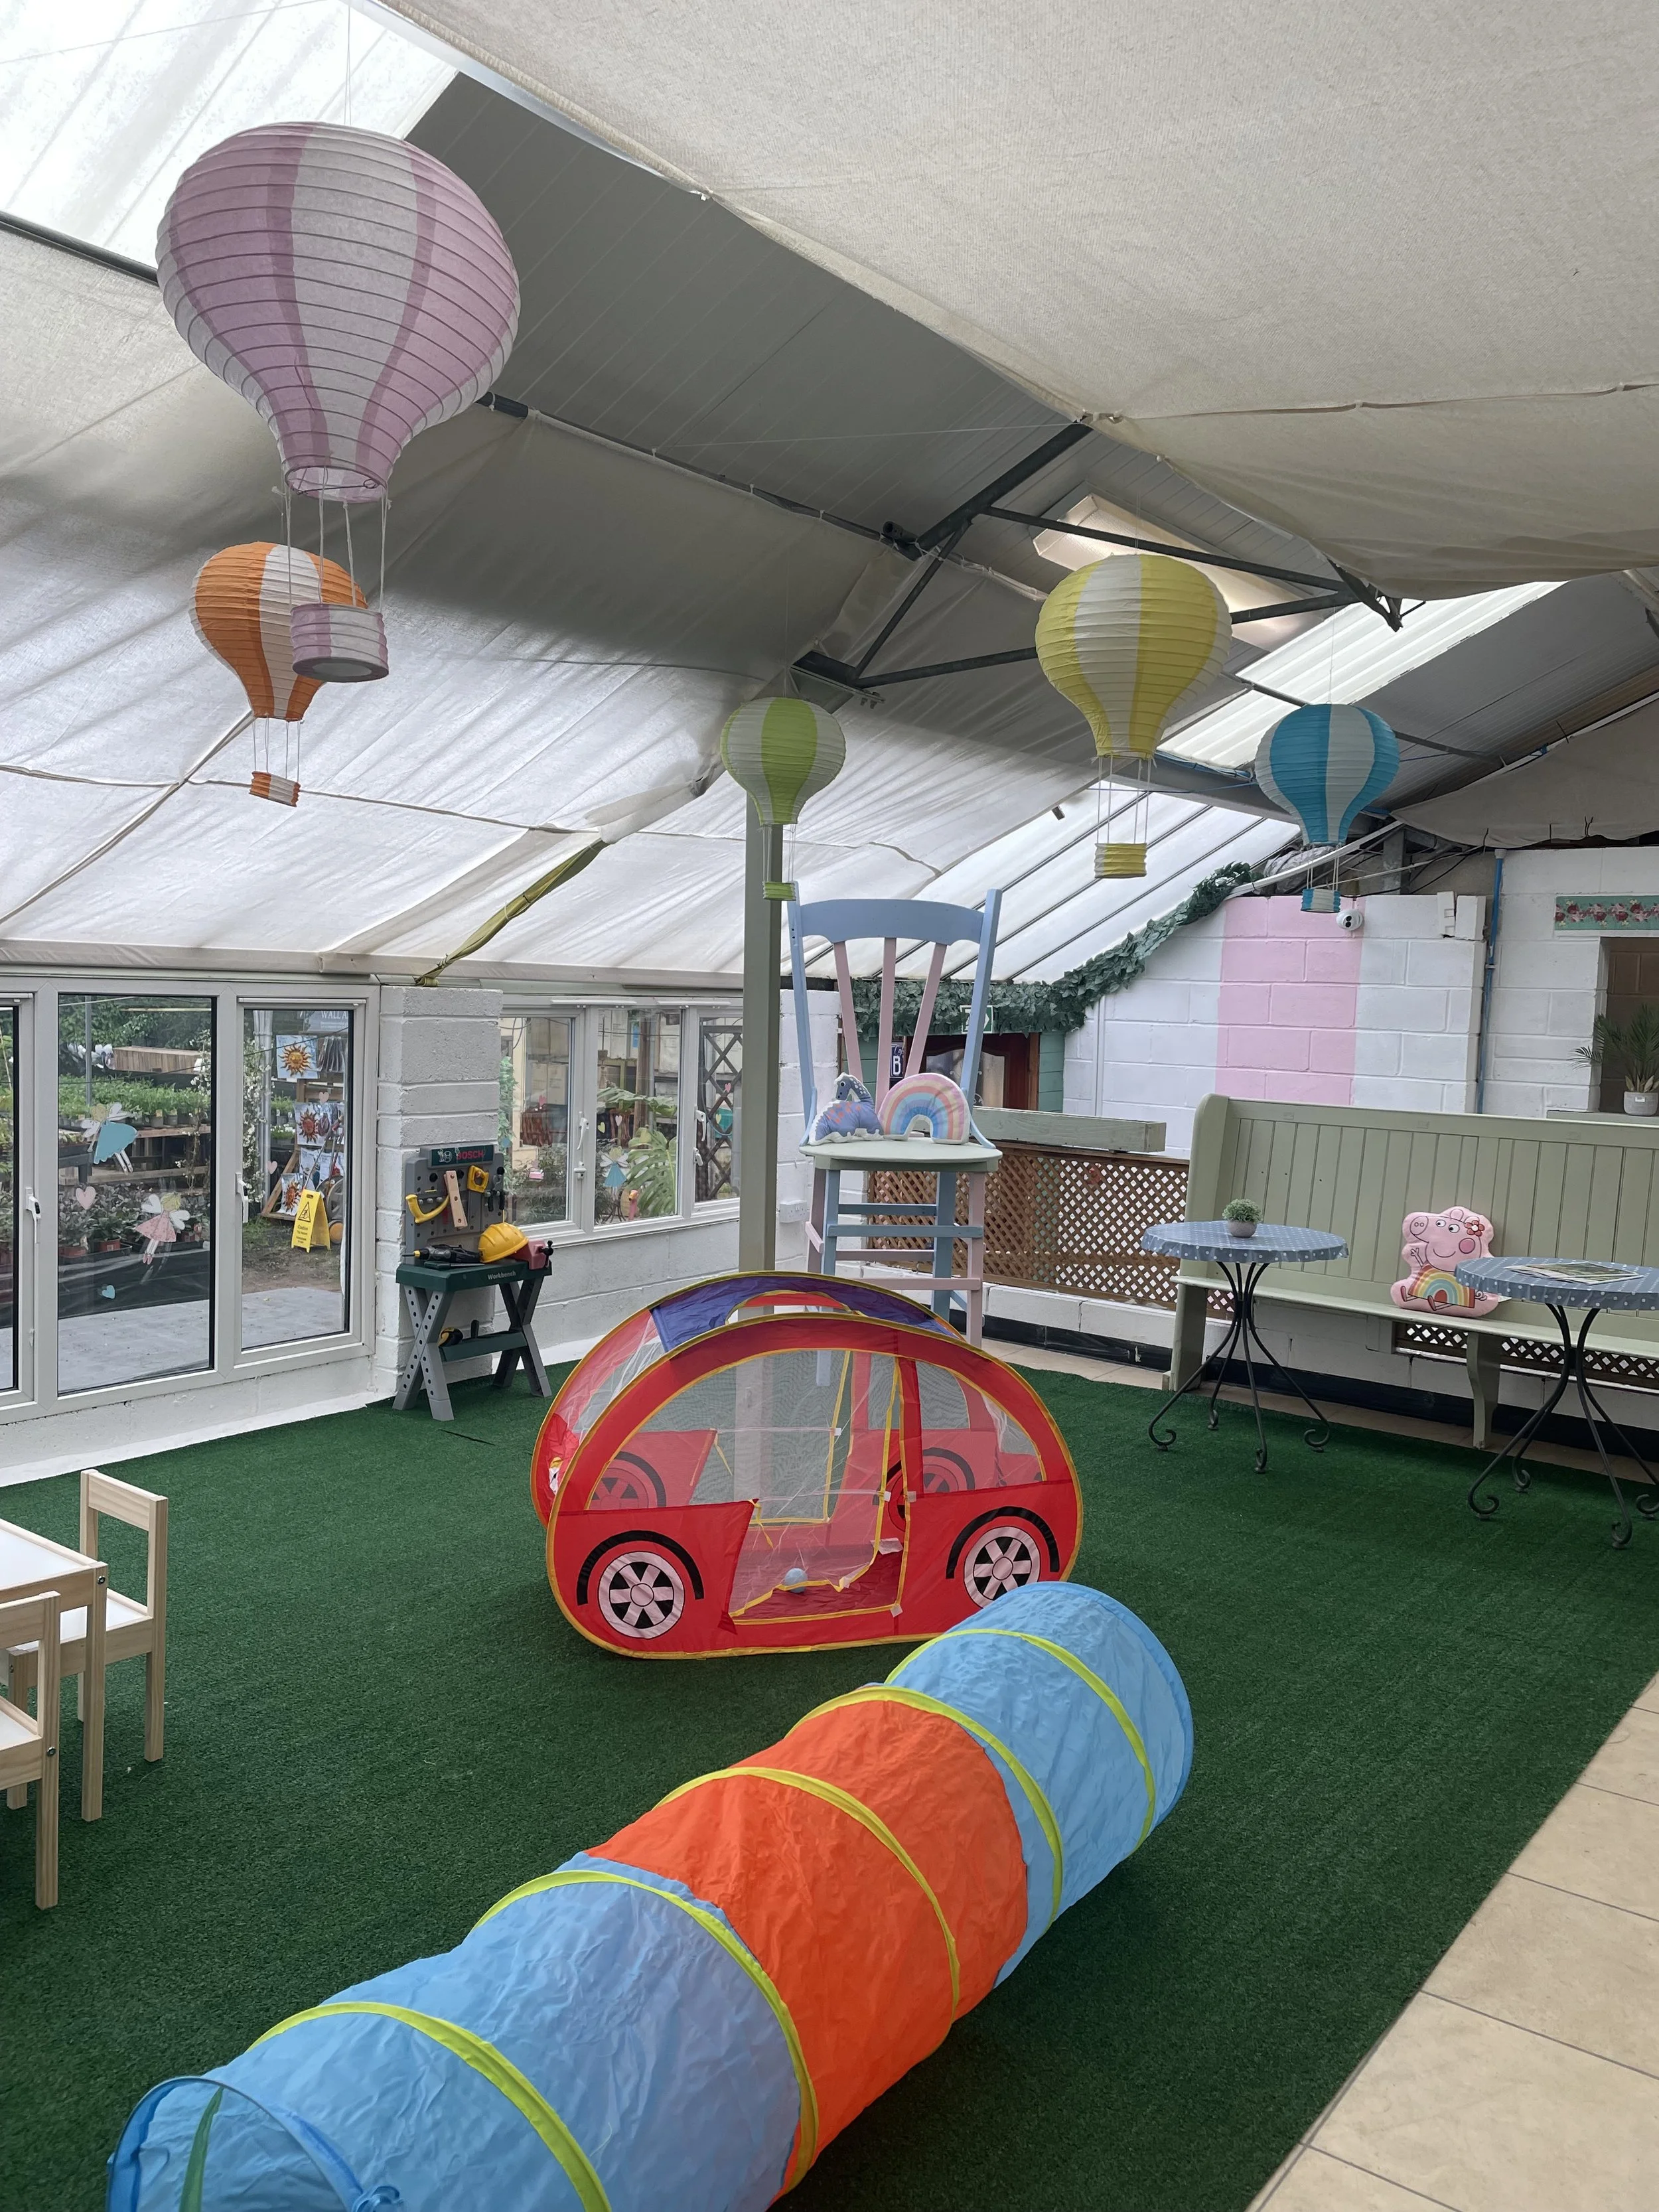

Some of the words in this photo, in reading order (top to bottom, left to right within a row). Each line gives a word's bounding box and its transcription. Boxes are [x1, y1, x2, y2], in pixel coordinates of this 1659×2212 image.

[321, 1011, 340, 1019] WALL
[341, 1011, 349, 1019] A
[893, 1055, 902, 1076] B
[456, 1149, 484, 1161] BOSCH
[487, 1270, 516, 1280] Workbench
